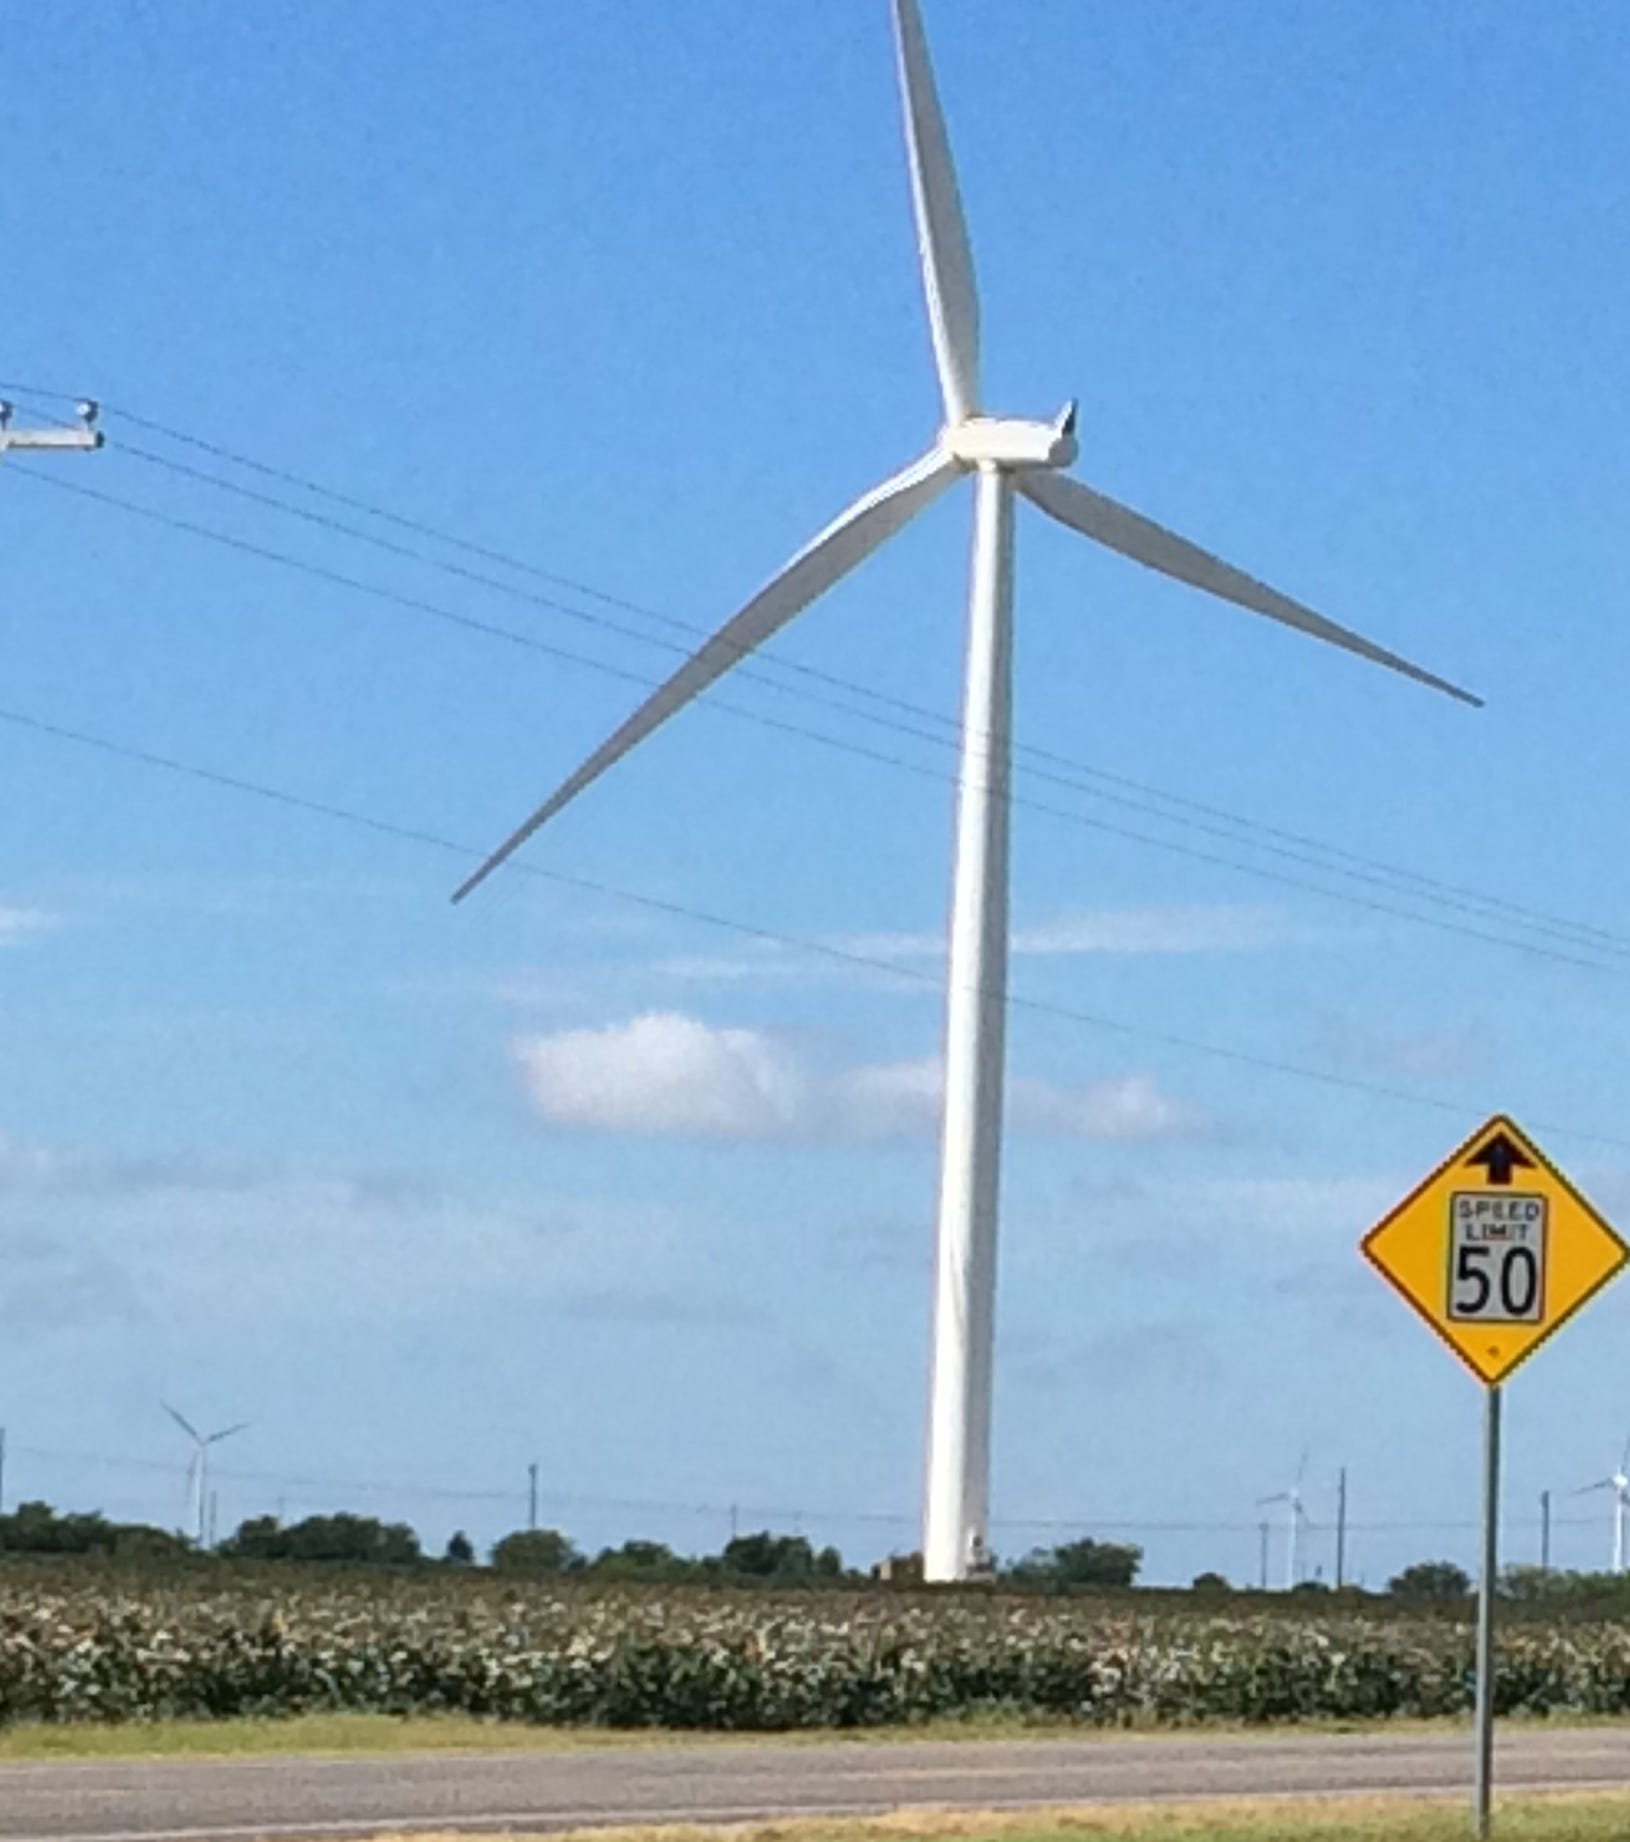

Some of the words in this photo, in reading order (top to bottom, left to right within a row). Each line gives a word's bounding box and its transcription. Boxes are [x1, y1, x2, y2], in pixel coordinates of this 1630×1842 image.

[1459, 1200, 1540, 1221] SPEED
[1465, 1223, 1529, 1241] LIMIT
[1455, 1246, 1537, 1316] 50
